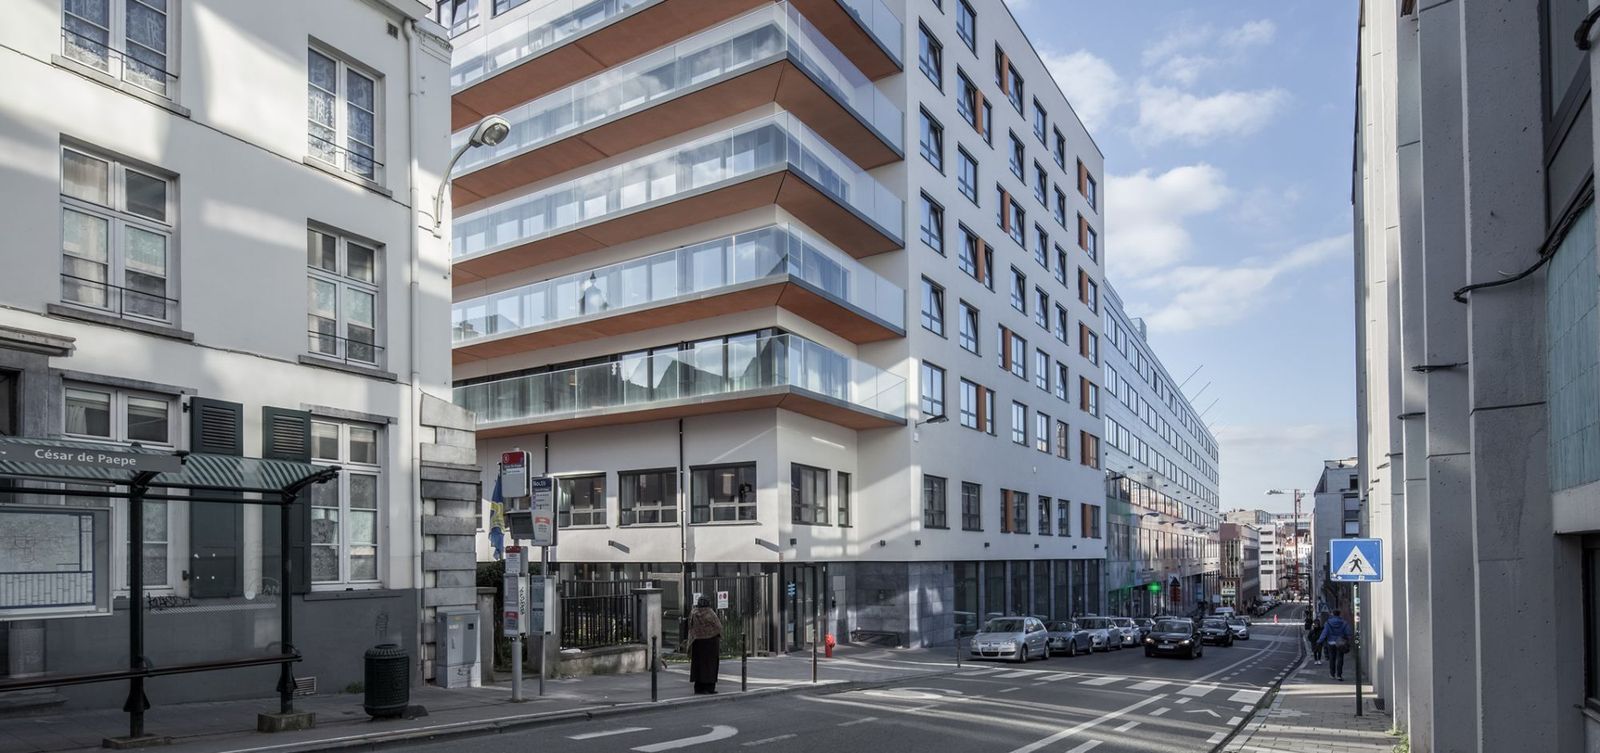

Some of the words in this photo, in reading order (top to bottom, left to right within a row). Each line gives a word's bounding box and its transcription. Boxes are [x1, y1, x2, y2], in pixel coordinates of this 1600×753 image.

[34, 448, 74, 461] César
[77, 452, 94, 463] de
[98, 454, 137, 467] Paepe
